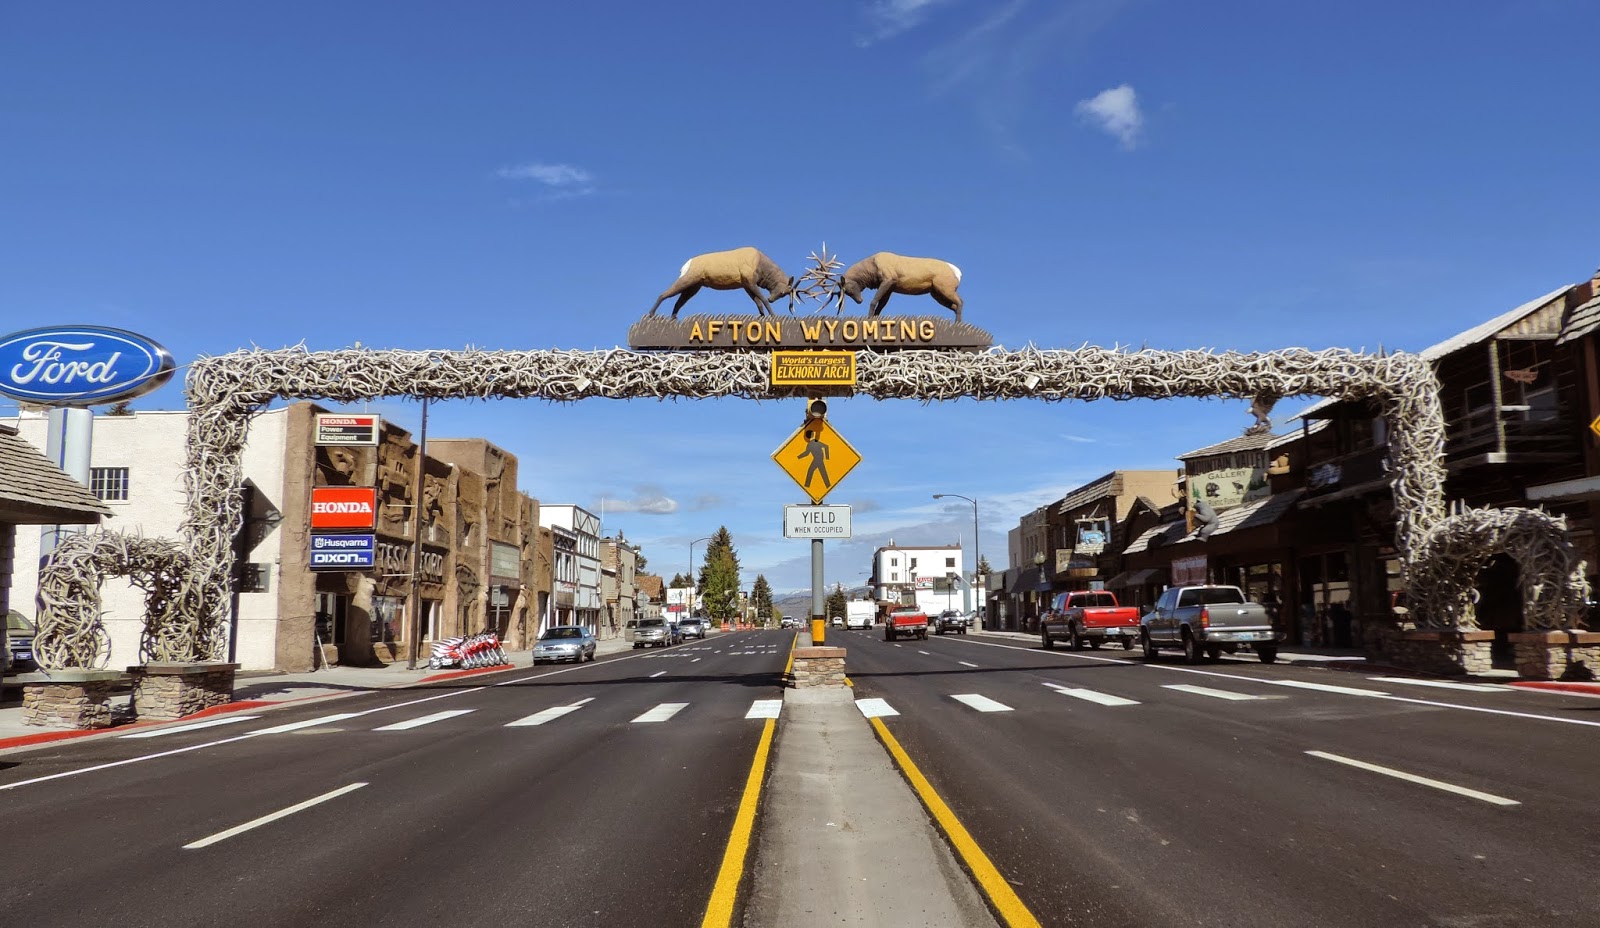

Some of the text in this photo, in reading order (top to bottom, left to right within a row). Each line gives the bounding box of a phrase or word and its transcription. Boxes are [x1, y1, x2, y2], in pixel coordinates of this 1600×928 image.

[689, 320, 935, 343] AFTON WYOMING
[10, 341, 122, 385] Ford
[814, 357, 846, 365] Largest
[777, 366, 850, 379] ELKHORN ARCH
[1207, 470, 1247, 480] GALLERY
[312, 502, 372, 513] HONDA
[802, 511, 836, 524] YIELD
[794, 526, 844, 534] WHEN OCCUPIED
[324, 538, 369, 548] Husqvarna
[314, 553, 359, 563] DIXON
[377, 542, 408, 572] TESY
